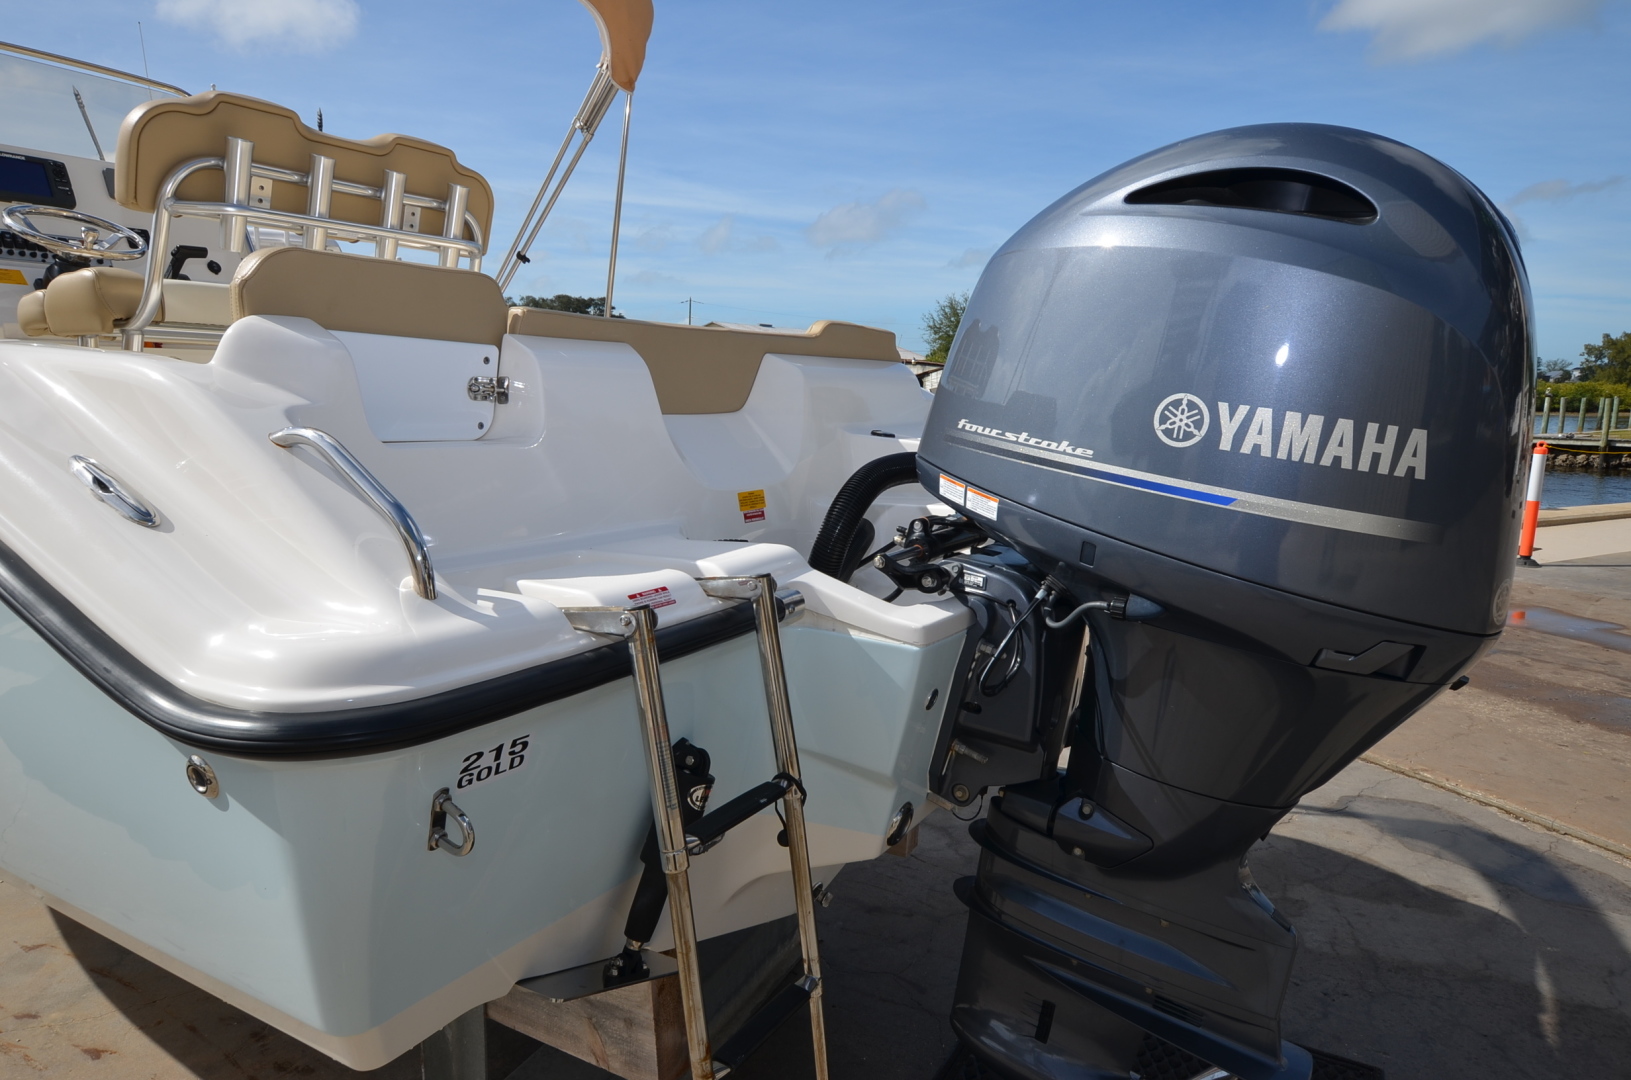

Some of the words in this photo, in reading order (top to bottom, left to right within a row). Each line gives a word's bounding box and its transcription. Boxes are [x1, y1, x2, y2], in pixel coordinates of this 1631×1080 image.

[1217, 401, 1428, 480] YAMAHA
[457, 754, 525, 789] GOLD
[459, 733, 530, 775] 215
